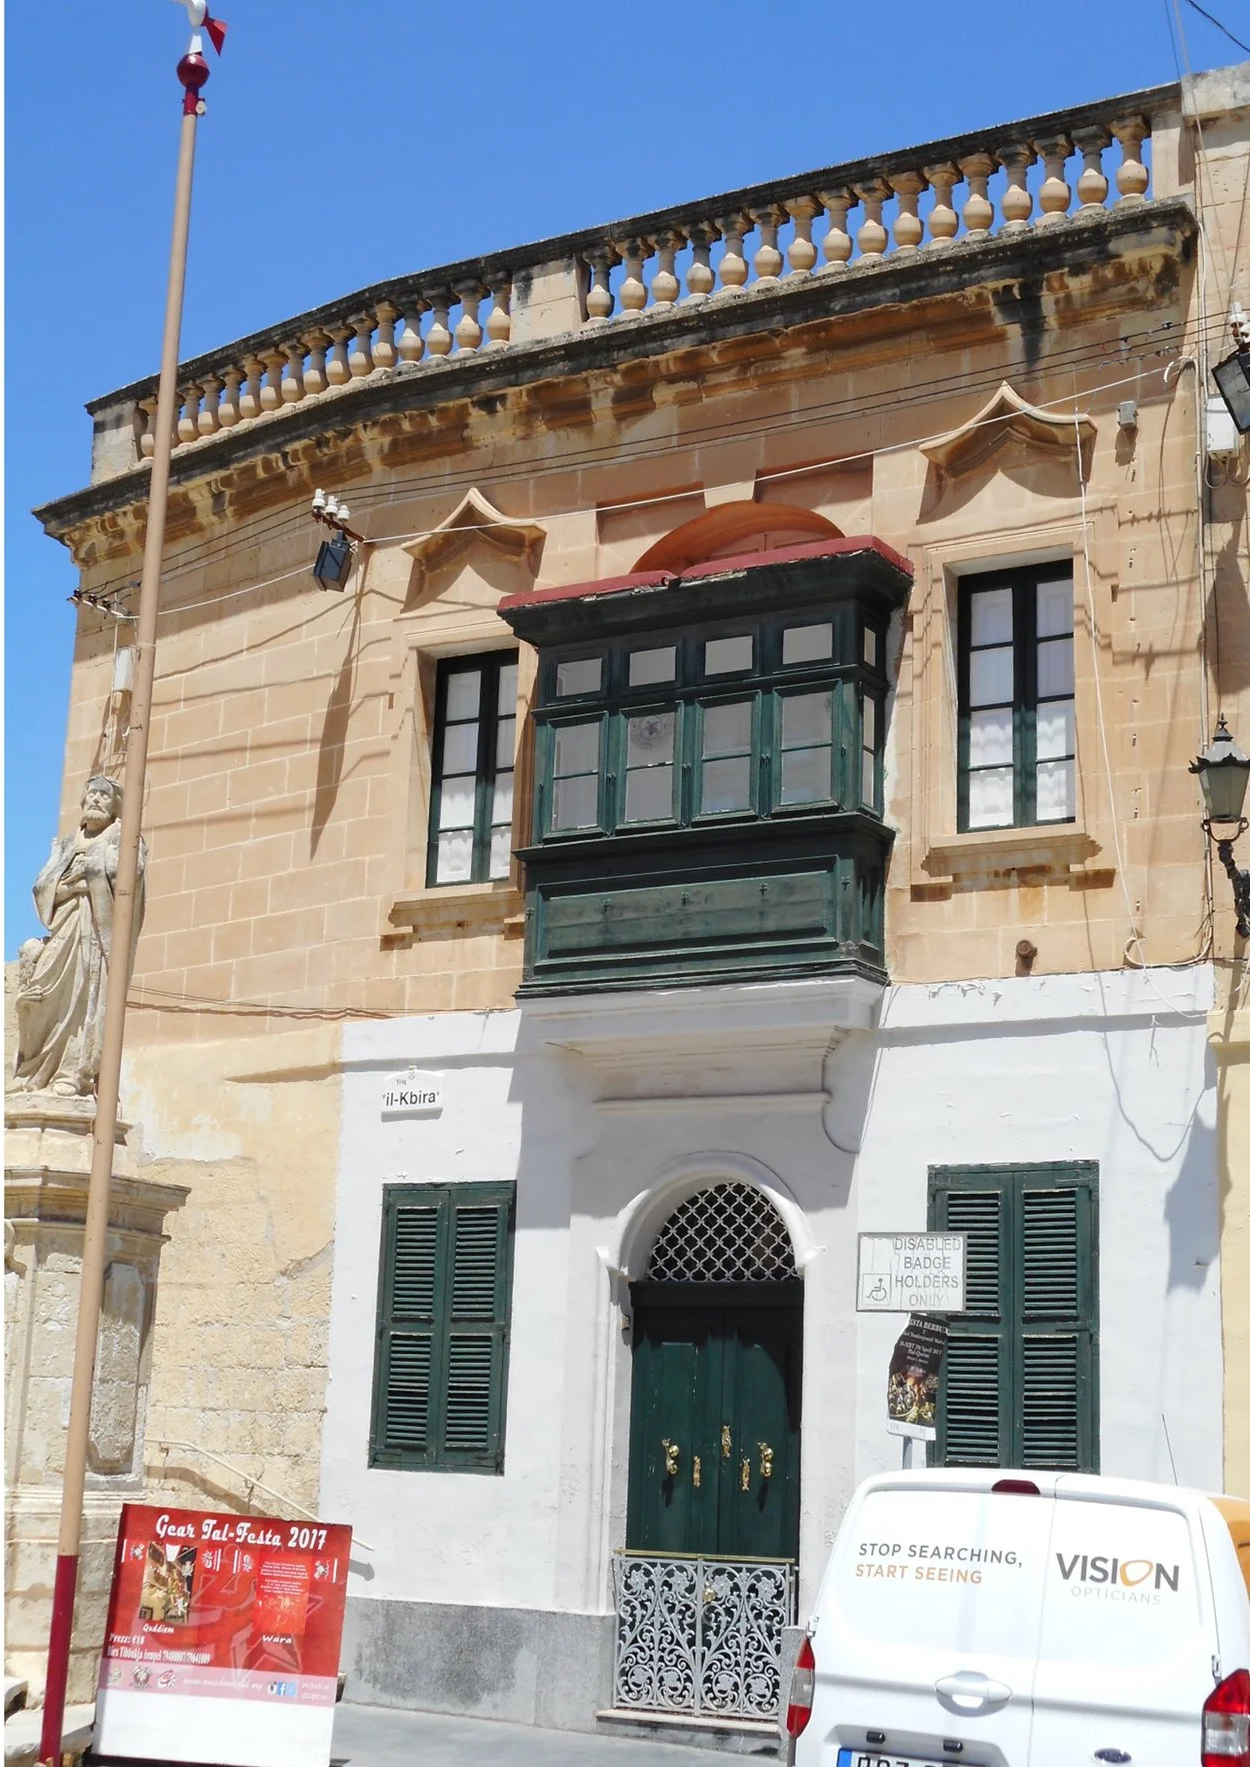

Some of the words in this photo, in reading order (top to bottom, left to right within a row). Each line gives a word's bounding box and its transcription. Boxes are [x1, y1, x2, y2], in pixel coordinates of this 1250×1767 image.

[895, 1237, 961, 1251] DISABLED
[904, 1256, 951, 1269] BADGE
[895, 1275, 959, 1288] HOLDERS
[909, 1294, 943, 1307] ONLY
[155, 1514, 196, 1539] Gear
[201, 1518, 282, 1547] Tal-Festa
[287, 1526, 327, 1550] 2017
[859, 1543, 902, 1557] STOP
[908, 1544, 1023, 1568] SEARCHING,
[855, 1564, 909, 1579] START
[915, 1566, 983, 1584] SEEING
[1056, 1552, 1180, 1592] VISION
[1071, 1585, 1161, 1606] OPTICIANS
[262, 1634, 293, 1644] Wara
